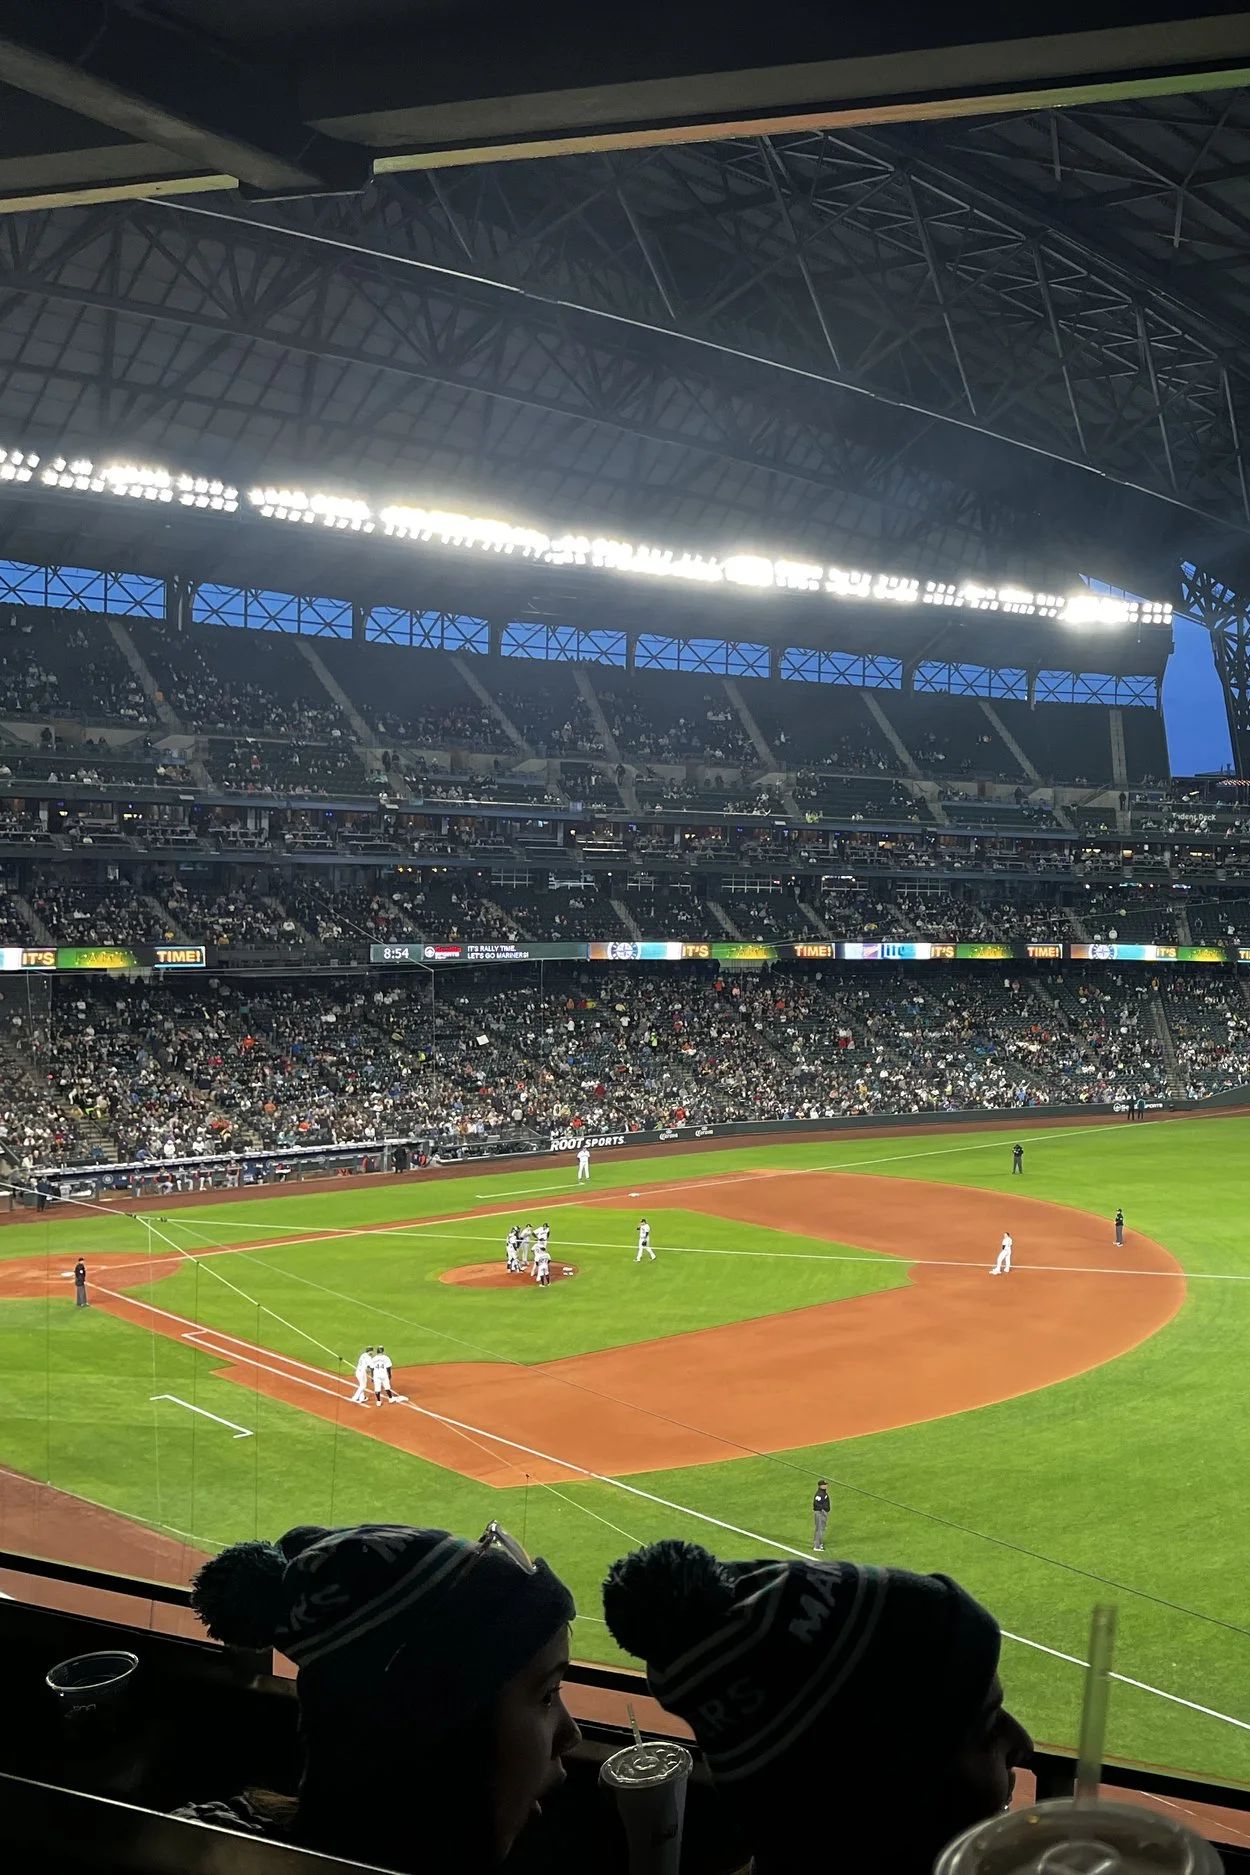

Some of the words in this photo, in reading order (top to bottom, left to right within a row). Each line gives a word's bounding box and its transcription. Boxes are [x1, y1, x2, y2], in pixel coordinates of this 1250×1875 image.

[383, 948, 410, 960] 8:54
[682, 945, 709, 957] IT'S
[794, 945, 832, 957] TIME!
[931, 946, 954, 958] IT'S
[1027, 946, 1060, 958] TIME!
[1156, 946, 1176, 957] IT'S
[22, 952, 55, 965] IT'S
[156, 950, 201, 963] TIME!
[550, 1137, 584, 1151] ROOT
[583, 1136, 624, 1148] SPORTS
